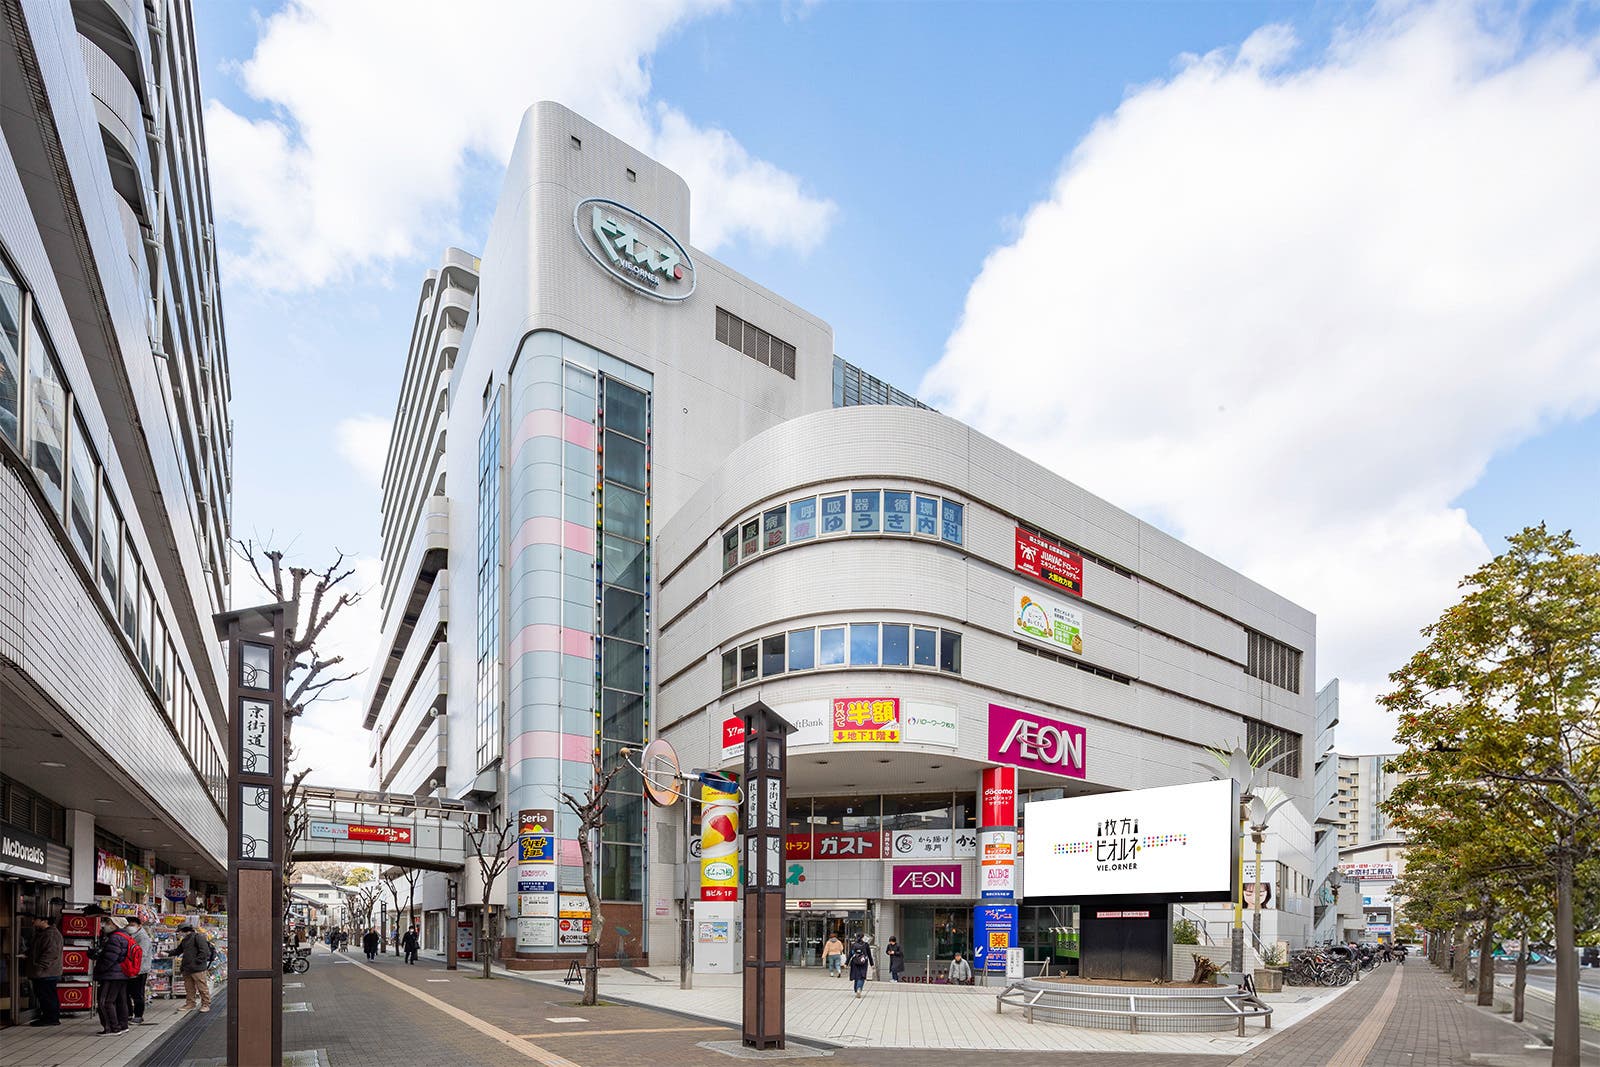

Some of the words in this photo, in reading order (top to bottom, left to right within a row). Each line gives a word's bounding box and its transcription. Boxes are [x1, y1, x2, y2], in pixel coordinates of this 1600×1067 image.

[835, 702, 846, 727] すべて
[848, 700, 896, 726] 半額
[247, 705, 267, 748] 京街道
[847, 731, 886, 741] 地下1階
[999, 719, 1083, 769] AEON
[1105, 817, 1132, 836] 枚方
[2, 837, 45, 865] McDonald's
[820, 836, 873, 855] ガスト
[898, 872, 954, 888] AEON
